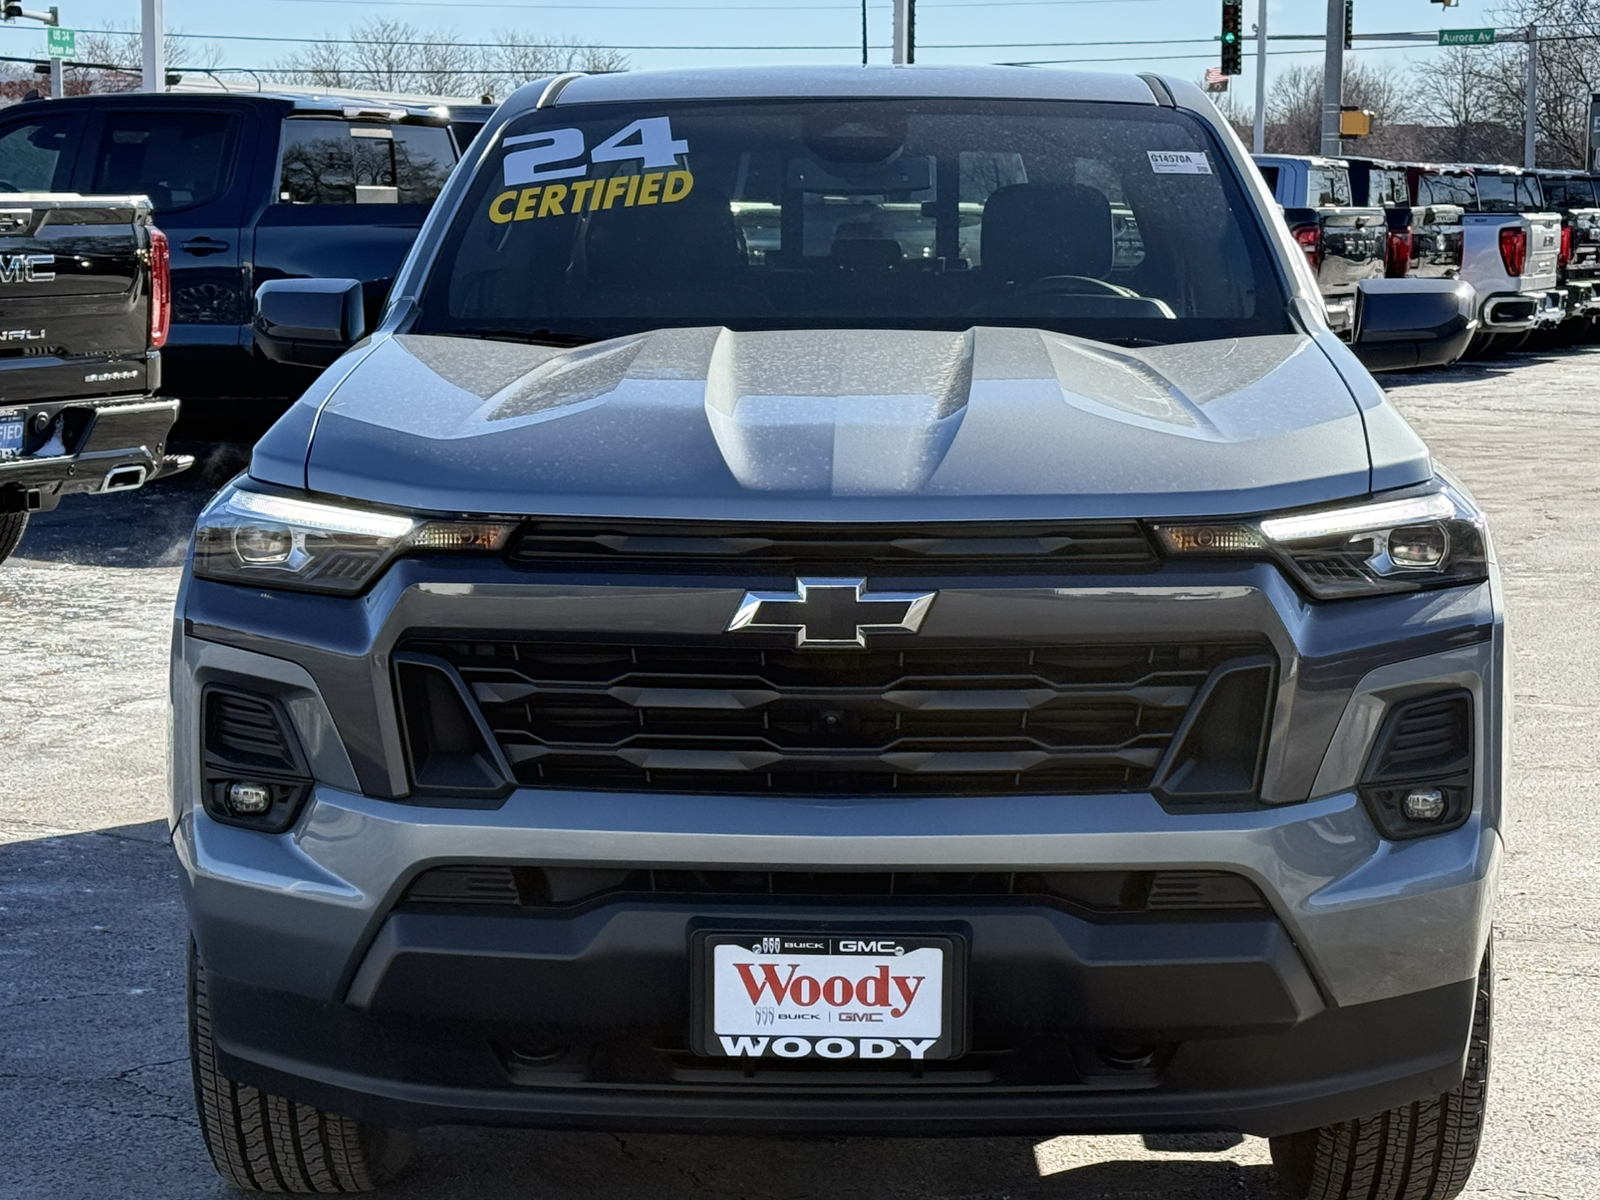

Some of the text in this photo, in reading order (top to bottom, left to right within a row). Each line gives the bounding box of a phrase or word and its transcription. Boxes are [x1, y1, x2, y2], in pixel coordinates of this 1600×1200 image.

[1442, 32, 1491, 42] Aurora Av
[502, 116, 690, 187] 24
[1150, 154, 1193, 163] G14570A
[488, 170, 694, 224] CERTIFIED
[839, 940, 897, 953] GMC
[732, 963, 926, 1018] Woody
[838, 1012, 884, 1023] GMC
[718, 1036, 938, 1060] WOODY
